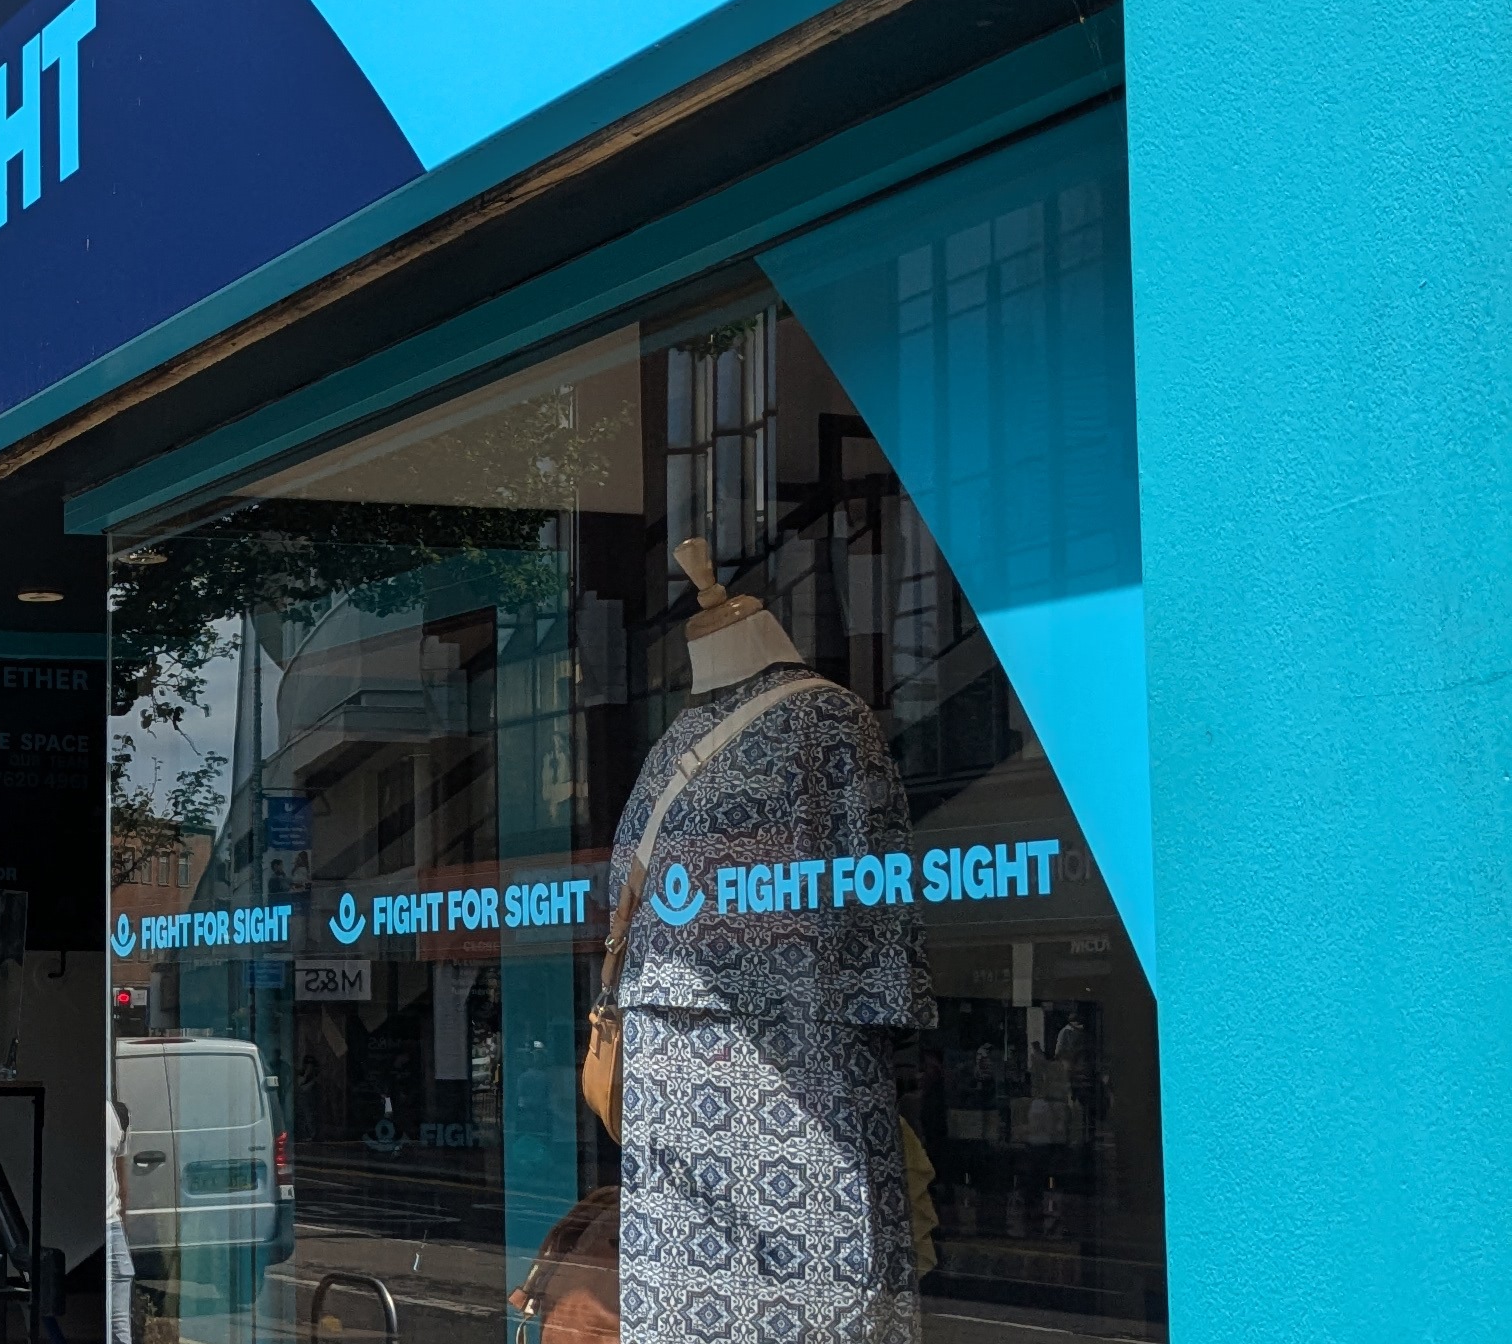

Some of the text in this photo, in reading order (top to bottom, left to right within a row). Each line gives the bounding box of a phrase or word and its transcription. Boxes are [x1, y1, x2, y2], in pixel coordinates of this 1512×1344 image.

[21, 732, 90, 753] SPACE
[716, 858, 826, 915] FIGHT
[832, 852, 914, 908] FOR
[922, 840, 1060, 903] SIGHT
[141, 905, 292, 950] FIGHT FOR SIGHT
[373, 880, 591, 936] FIGHT FOR SIGHT
[420, 1122, 483, 1148] FIGH
